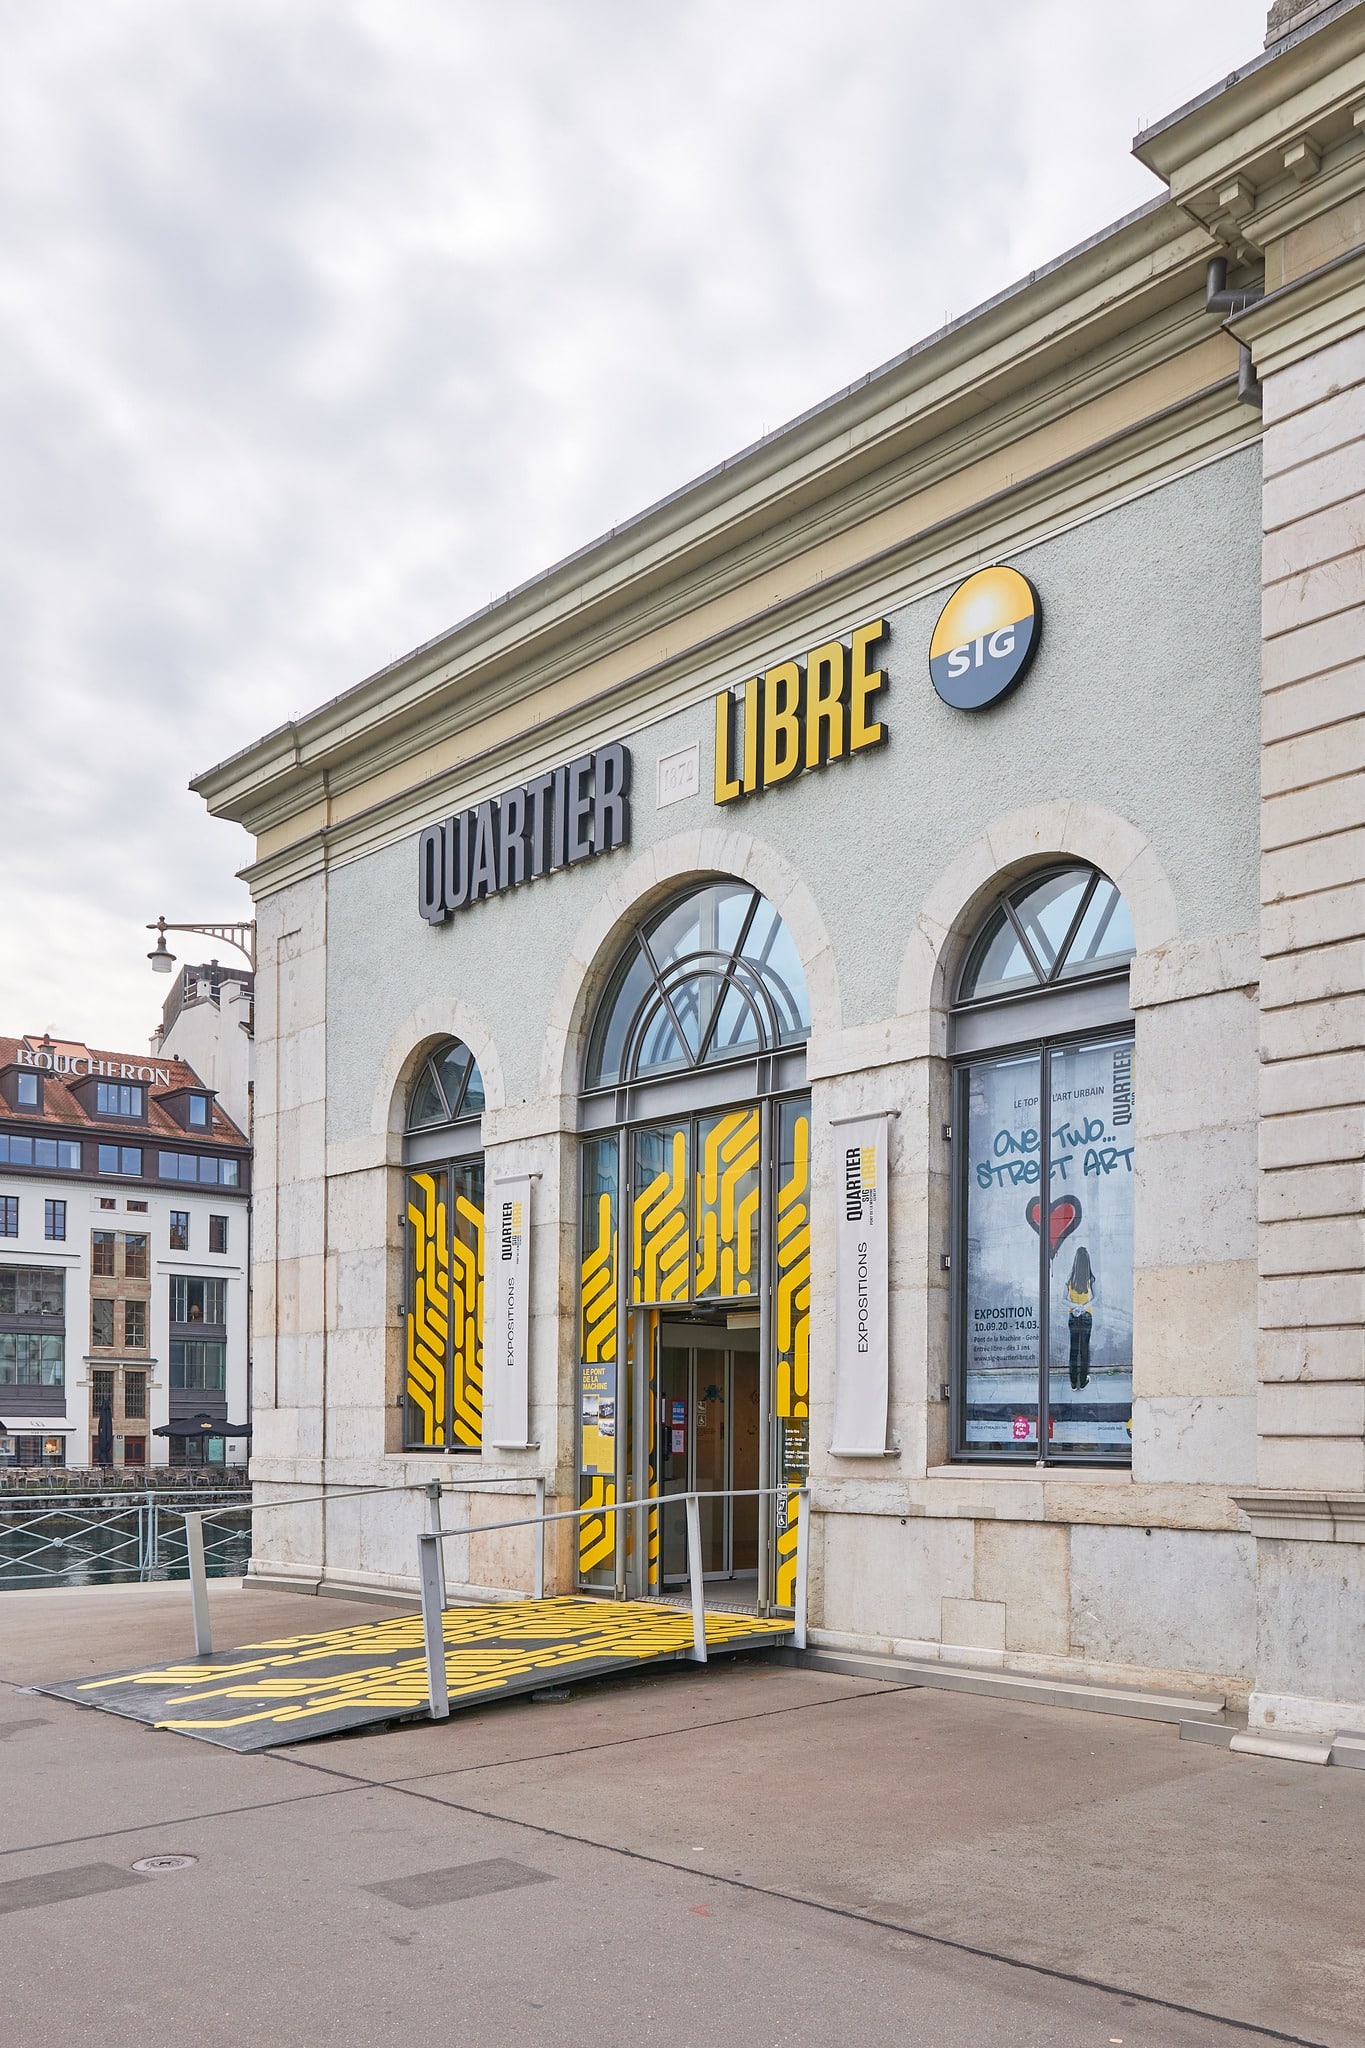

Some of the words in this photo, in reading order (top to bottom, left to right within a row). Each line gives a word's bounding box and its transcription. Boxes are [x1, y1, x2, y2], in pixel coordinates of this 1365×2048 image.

[947, 625, 1015, 678] SIG
[418, 742, 632, 927] QUARTIER
[714, 618, 890, 807] LIBRE
[664, 760, 694, 792] 1872
[17, 1049, 170, 1087] BOUCHERON
[1013, 1099, 1022, 1109] LE
[1024, 1097, 1039, 1107] TOP
[1052, 1091, 1073, 1103] L'ART
[1073, 1086, 1105, 1099] URBAIN
[1112, 1048, 1132, 1127] QUARTIER
[1083, 1147, 1135, 1177] ART
[845, 1146, 863, 1222] QUARTIER
[861, 1189, 870, 1203] SIG
[501, 1201, 513, 1261] QUARTIER
[857, 1241, 869, 1353] EXPOSITIONS
[974, 1306, 1033, 1320] EXPOSITION
[507, 1276, 515, 1367] EXPOSITIONS
[975, 1321, 1008, 1332] 10.09.20
[1014, 1320, 1040, 1330] 14.03.
[582, 1368, 590, 1376] LE
[590, 1367, 606, 1376] PONT
